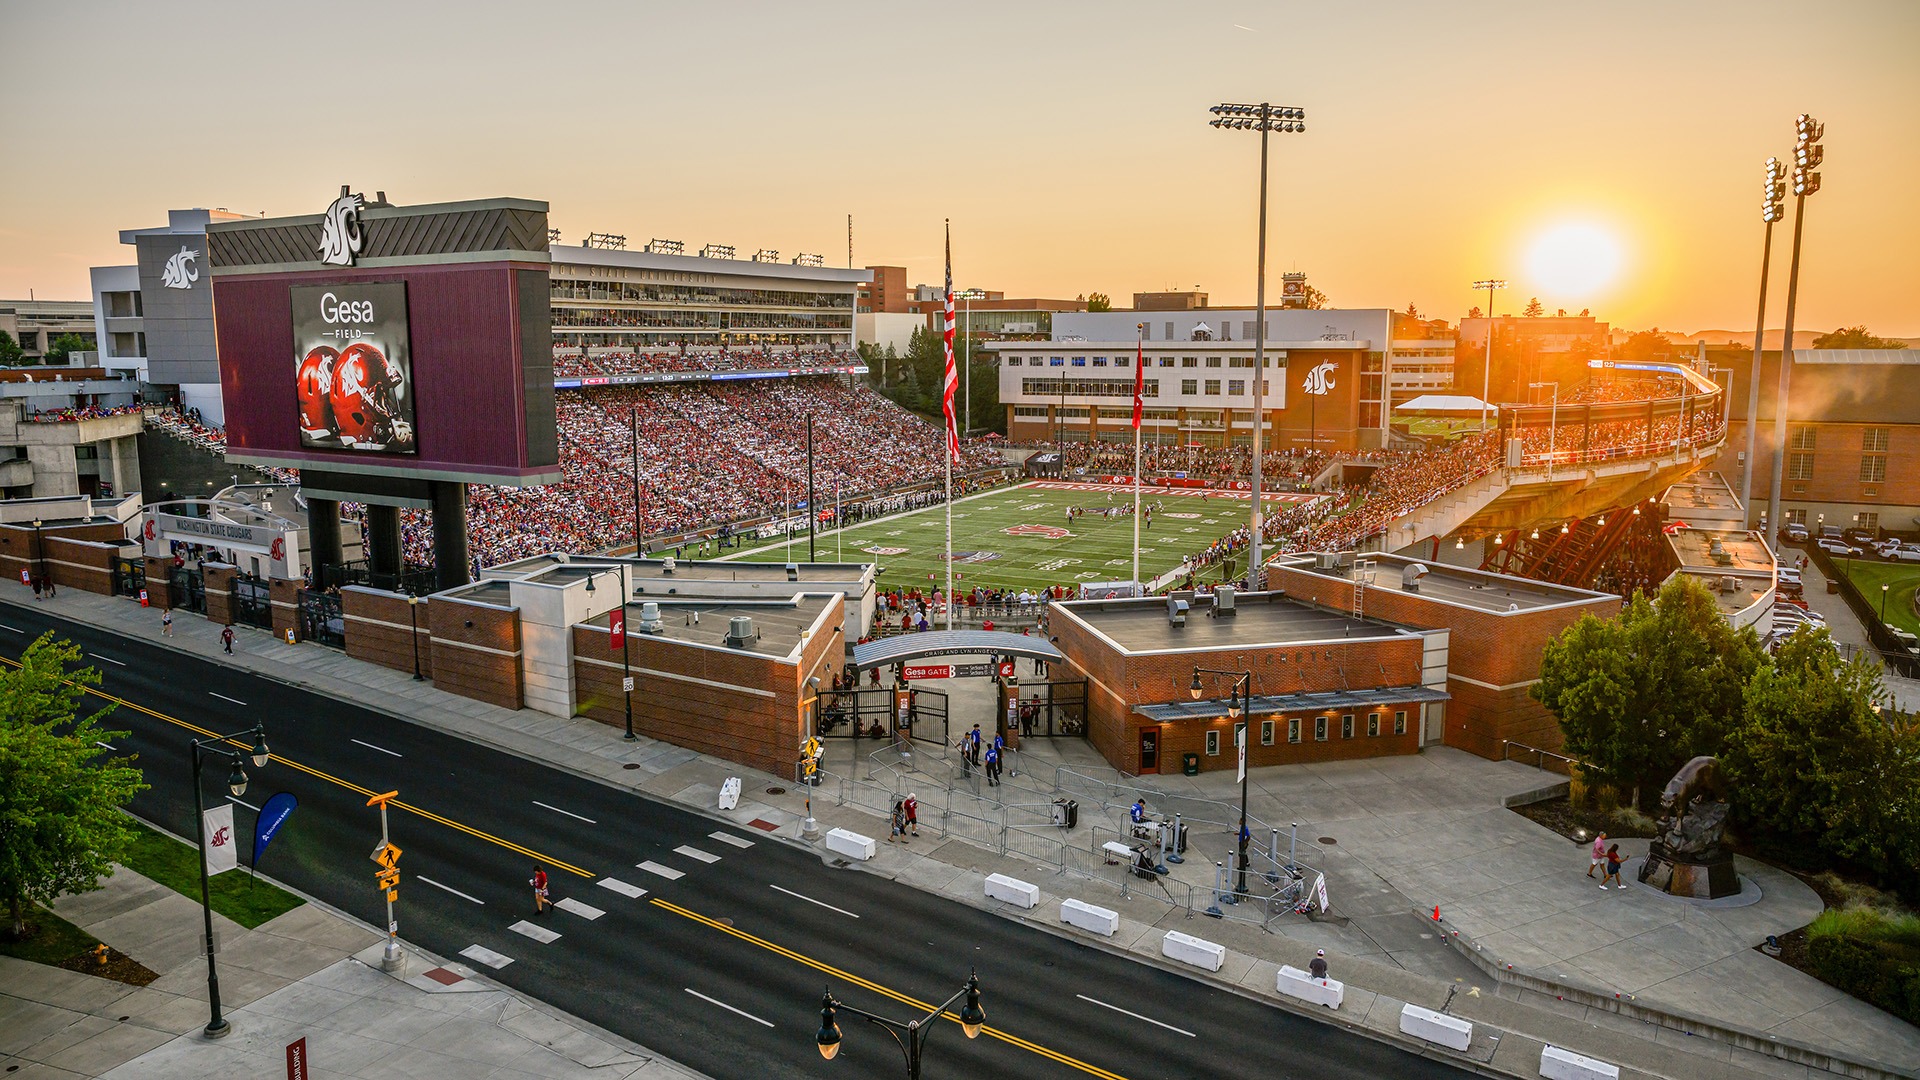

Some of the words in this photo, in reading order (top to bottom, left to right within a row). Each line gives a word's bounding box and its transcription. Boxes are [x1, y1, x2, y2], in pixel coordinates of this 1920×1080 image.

[590, 266, 628, 279] STATE
[641, 270, 717, 284] UNIVERSITY
[320, 292, 374, 324] Gesa
[335, 329, 362, 339] FIELD
[176, 519, 209, 534] WASHINGTON
[210, 524, 225, 536] STATE
[227, 526, 252, 540] COUGARS
[1237, 651, 1332, 668] TICKETS
[904, 667, 926, 676] Gesa
[927, 668, 948, 676] GATE
[949, 665, 956, 678] B
[624, 683, 634, 691] 20
[266, 817, 282, 836] COLUMBIA
[280, 807, 290, 818] BANK
